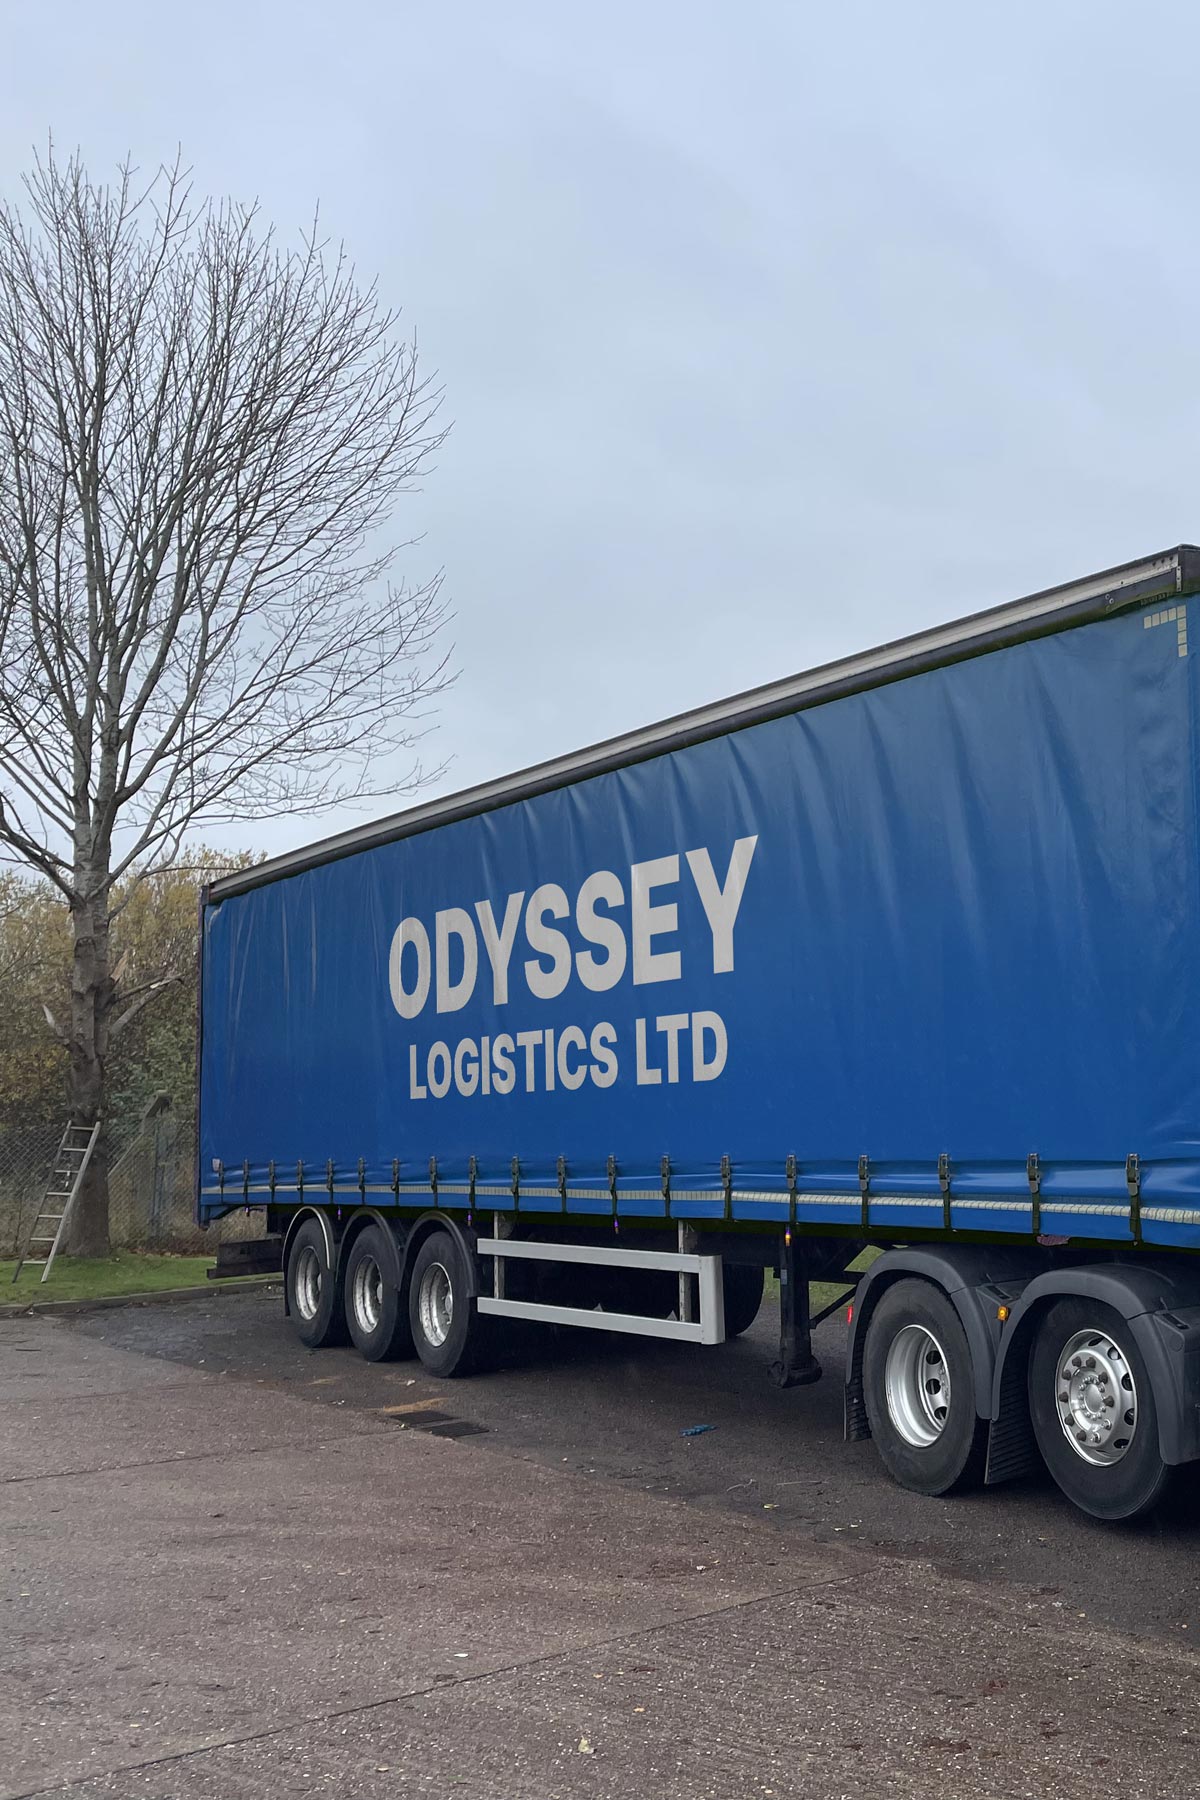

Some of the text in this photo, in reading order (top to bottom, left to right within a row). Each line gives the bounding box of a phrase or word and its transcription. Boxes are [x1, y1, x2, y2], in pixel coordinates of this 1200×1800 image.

[389, 835, 758, 1019] ODYSSEY
[409, 1010, 728, 1100] LOGISTICS LTD
